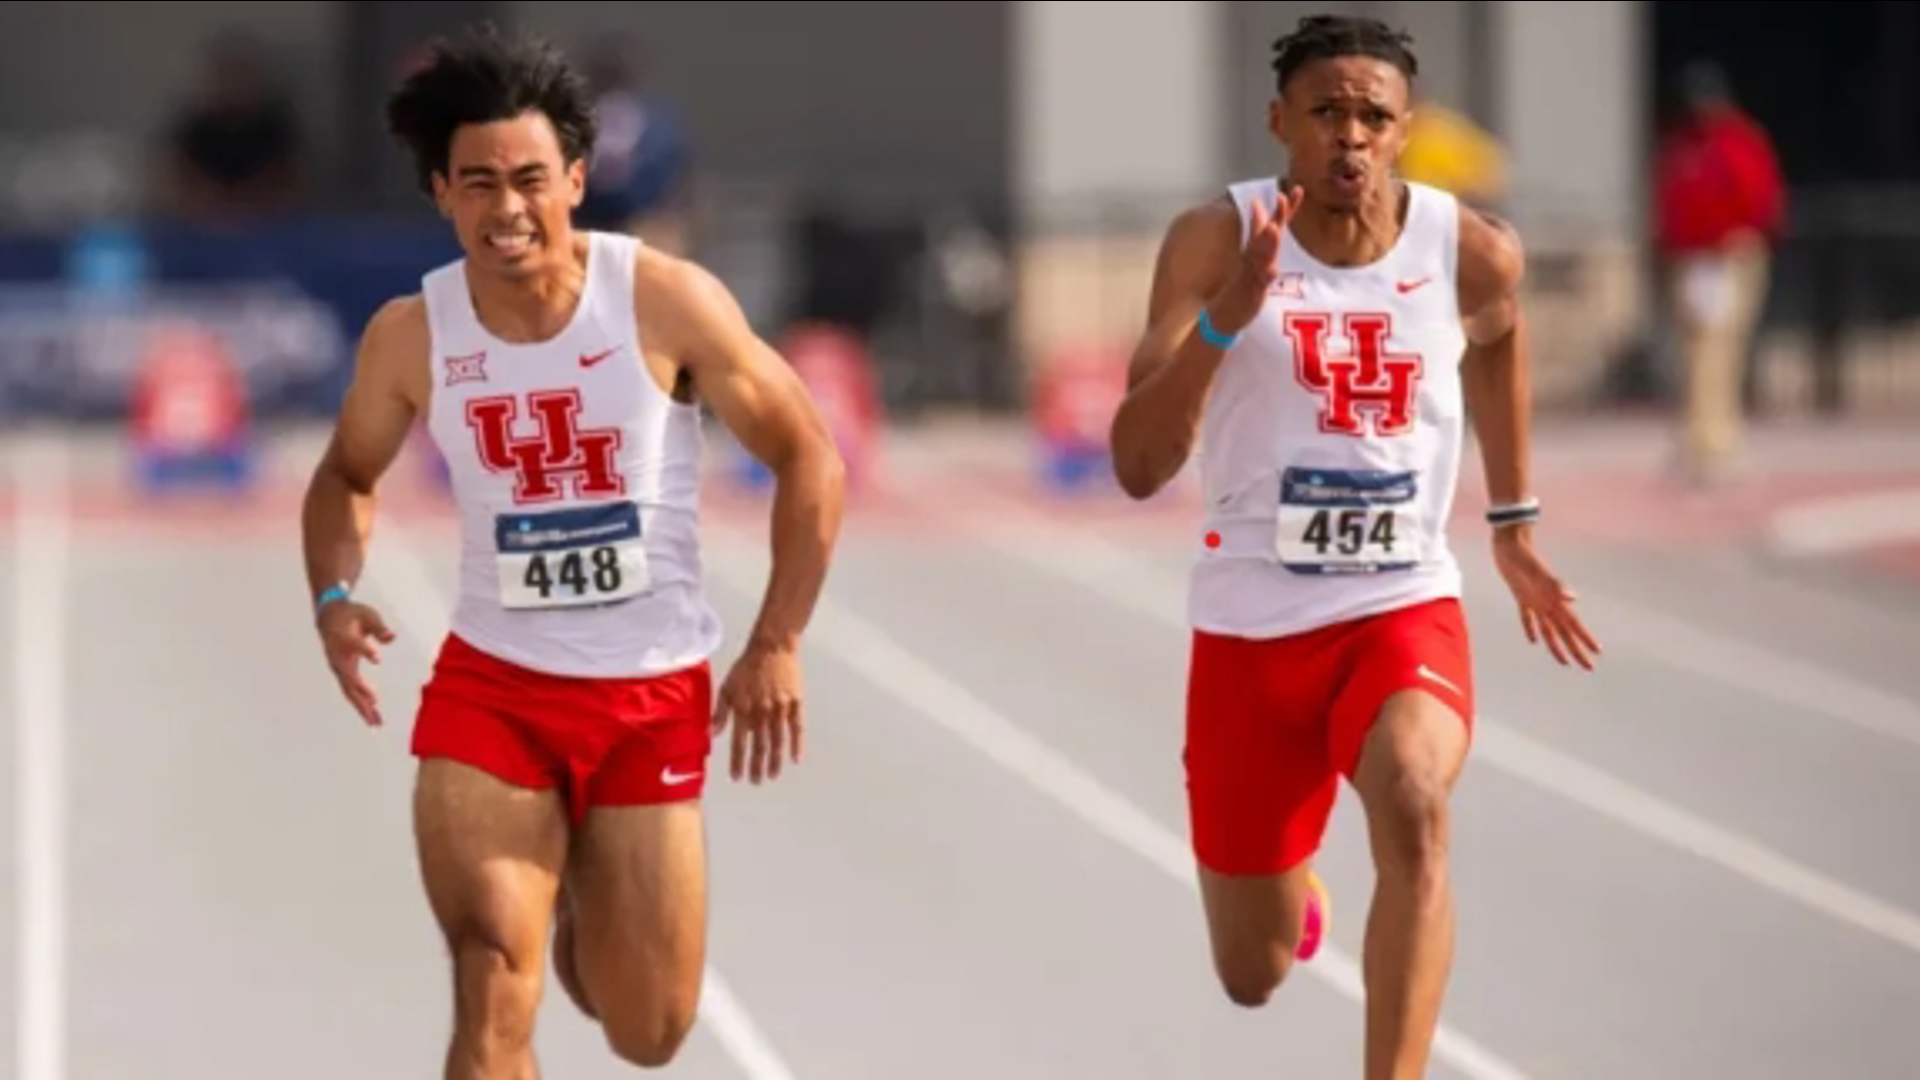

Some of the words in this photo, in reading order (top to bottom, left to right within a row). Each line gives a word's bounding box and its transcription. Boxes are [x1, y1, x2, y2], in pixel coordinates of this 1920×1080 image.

[1284, 312, 1423, 437] UH
[466, 387, 625, 505] UH
[524, 546, 621, 598] 448
[1301, 509, 1398, 554] 454
